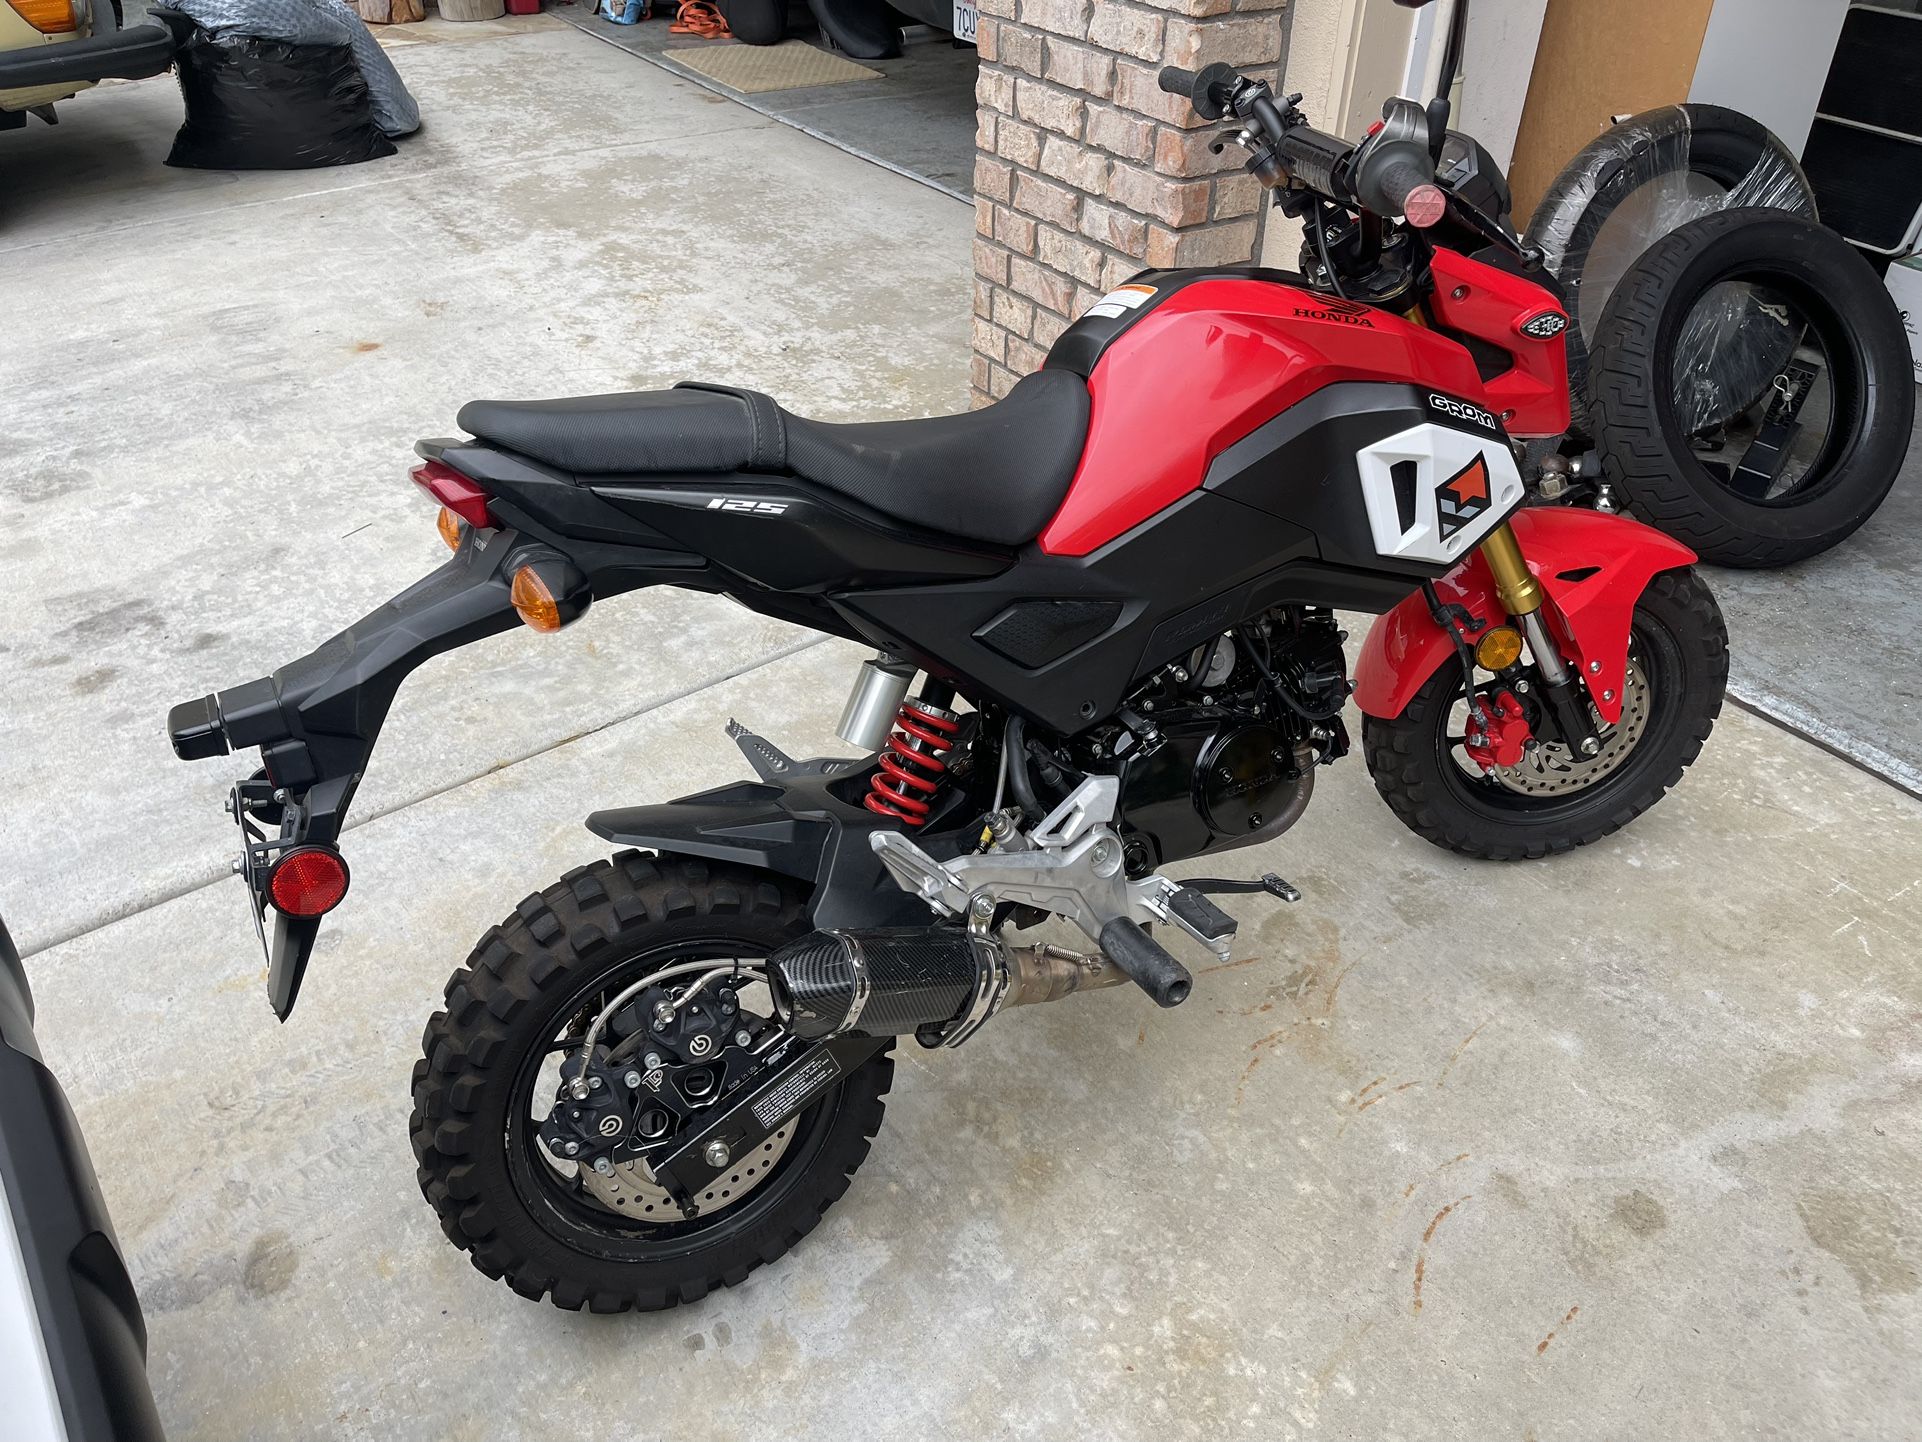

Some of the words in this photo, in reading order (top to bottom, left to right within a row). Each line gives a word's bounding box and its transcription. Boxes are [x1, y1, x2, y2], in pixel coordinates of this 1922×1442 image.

[1293, 307, 1375, 328] HONDA
[1429, 394, 1496, 430] GROM
[706, 498, 789, 515] 125
